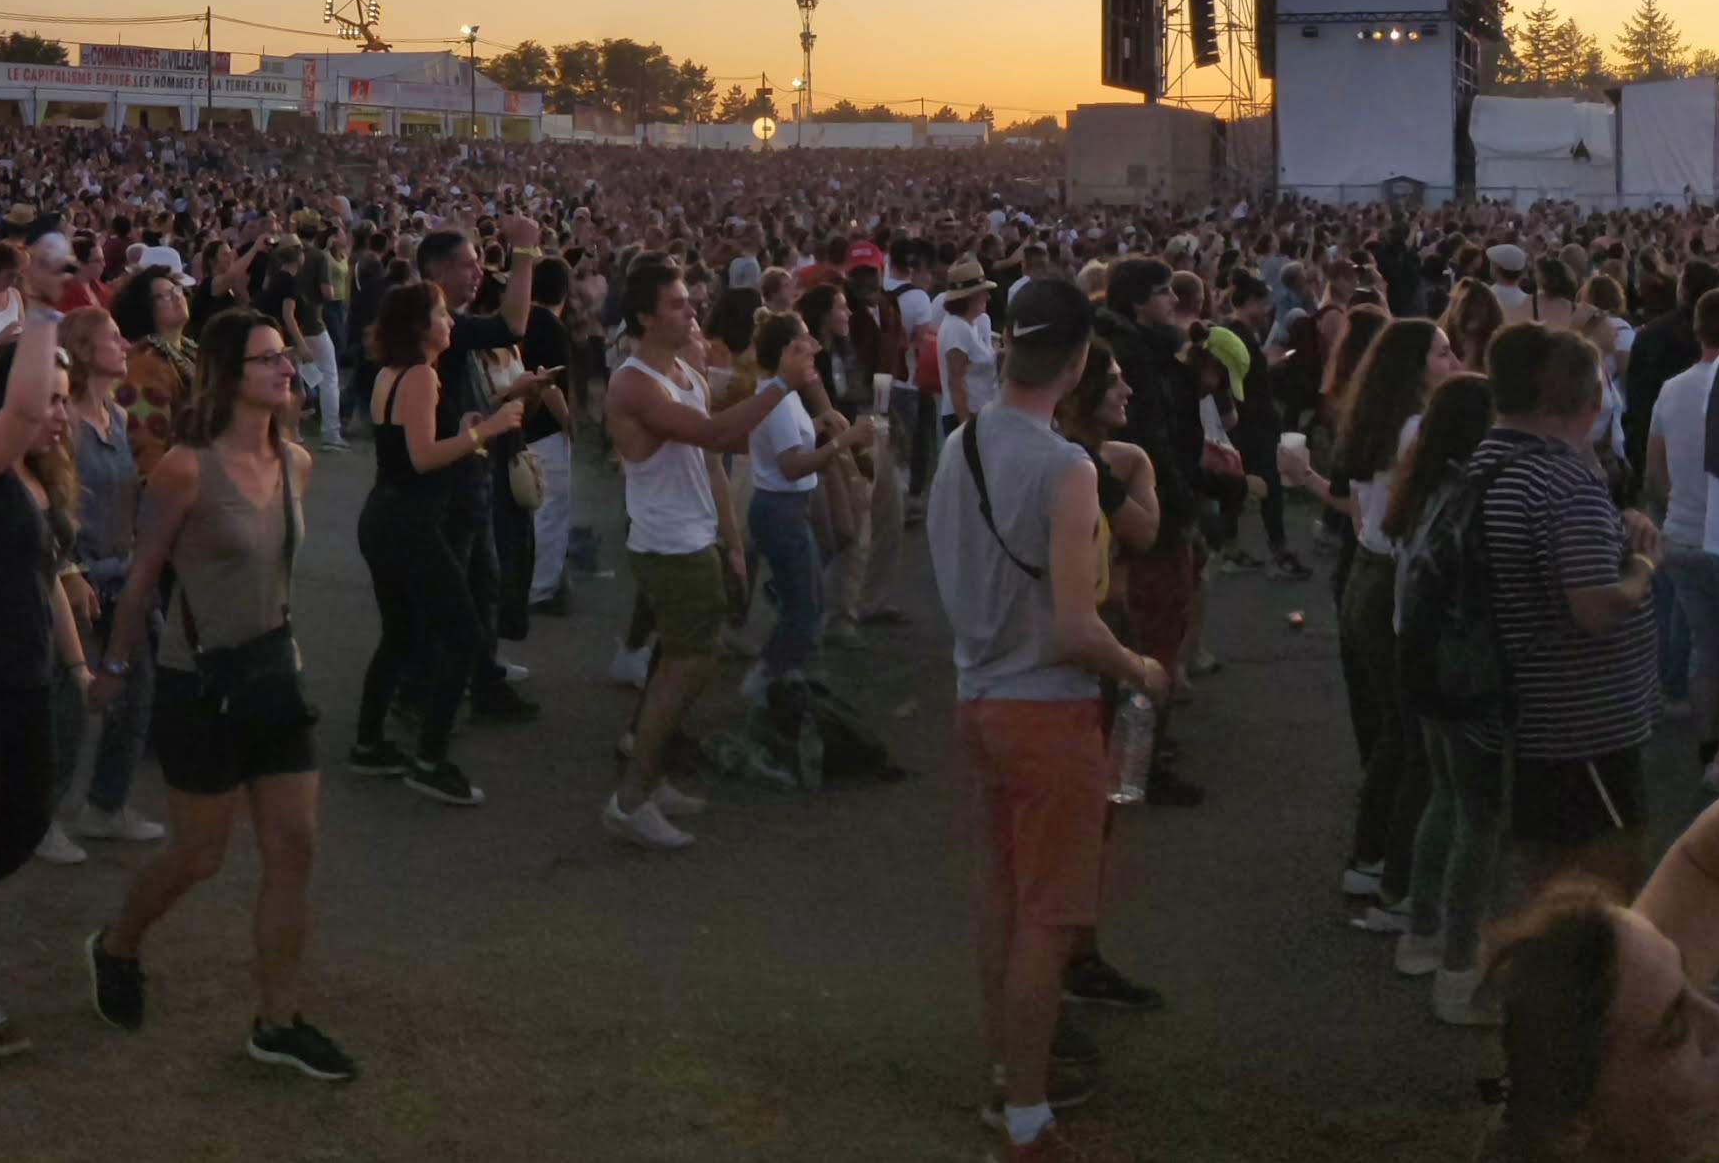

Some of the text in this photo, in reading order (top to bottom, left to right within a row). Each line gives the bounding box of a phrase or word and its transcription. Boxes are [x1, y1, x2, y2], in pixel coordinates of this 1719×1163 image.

[91, 46, 160, 69] COMMUNISTES
[7, 68, 19, 81] LE
[23, 69, 92, 85] CAPITALISME
[153, 75, 194, 90] HOMMES
